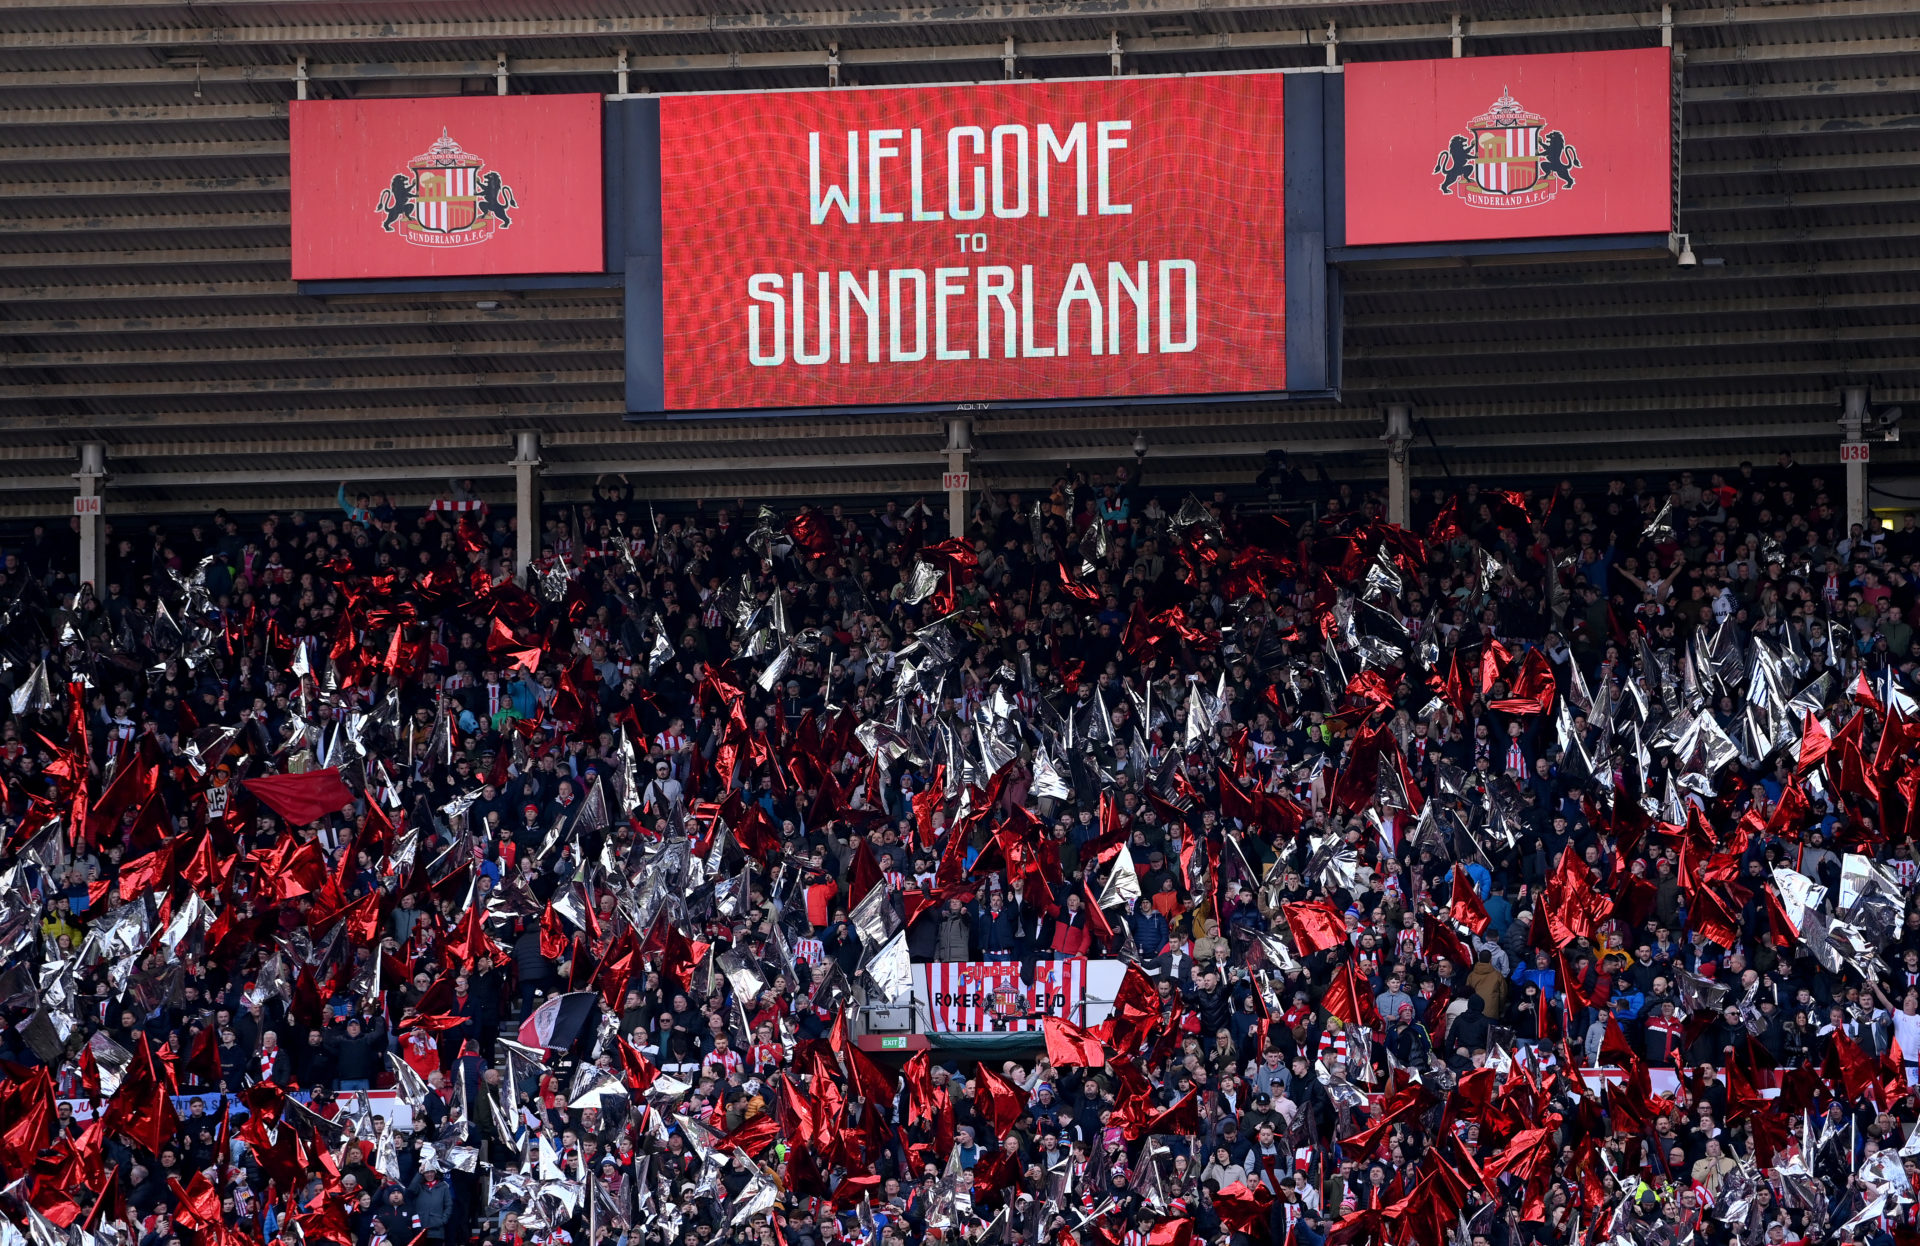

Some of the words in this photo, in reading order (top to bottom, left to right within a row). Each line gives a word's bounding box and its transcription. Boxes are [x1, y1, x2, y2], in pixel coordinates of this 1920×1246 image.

[809, 120, 1132, 225] WELCOME
[1467, 193, 1522, 206] SUNDERLAND
[408, 231, 461, 244] SUNDERLAND
[956, 233, 987, 253] TO
[748, 259, 1197, 367] SUNDERLAND
[1841, 445, 1869, 460] U38
[944, 475, 968, 488] U37
[76, 499, 98, 512] U14
[965, 965, 1047, 984] SUNDERLD
[935, 992, 981, 1008] ROKER
[883, 1039, 898, 1047] EXIT
